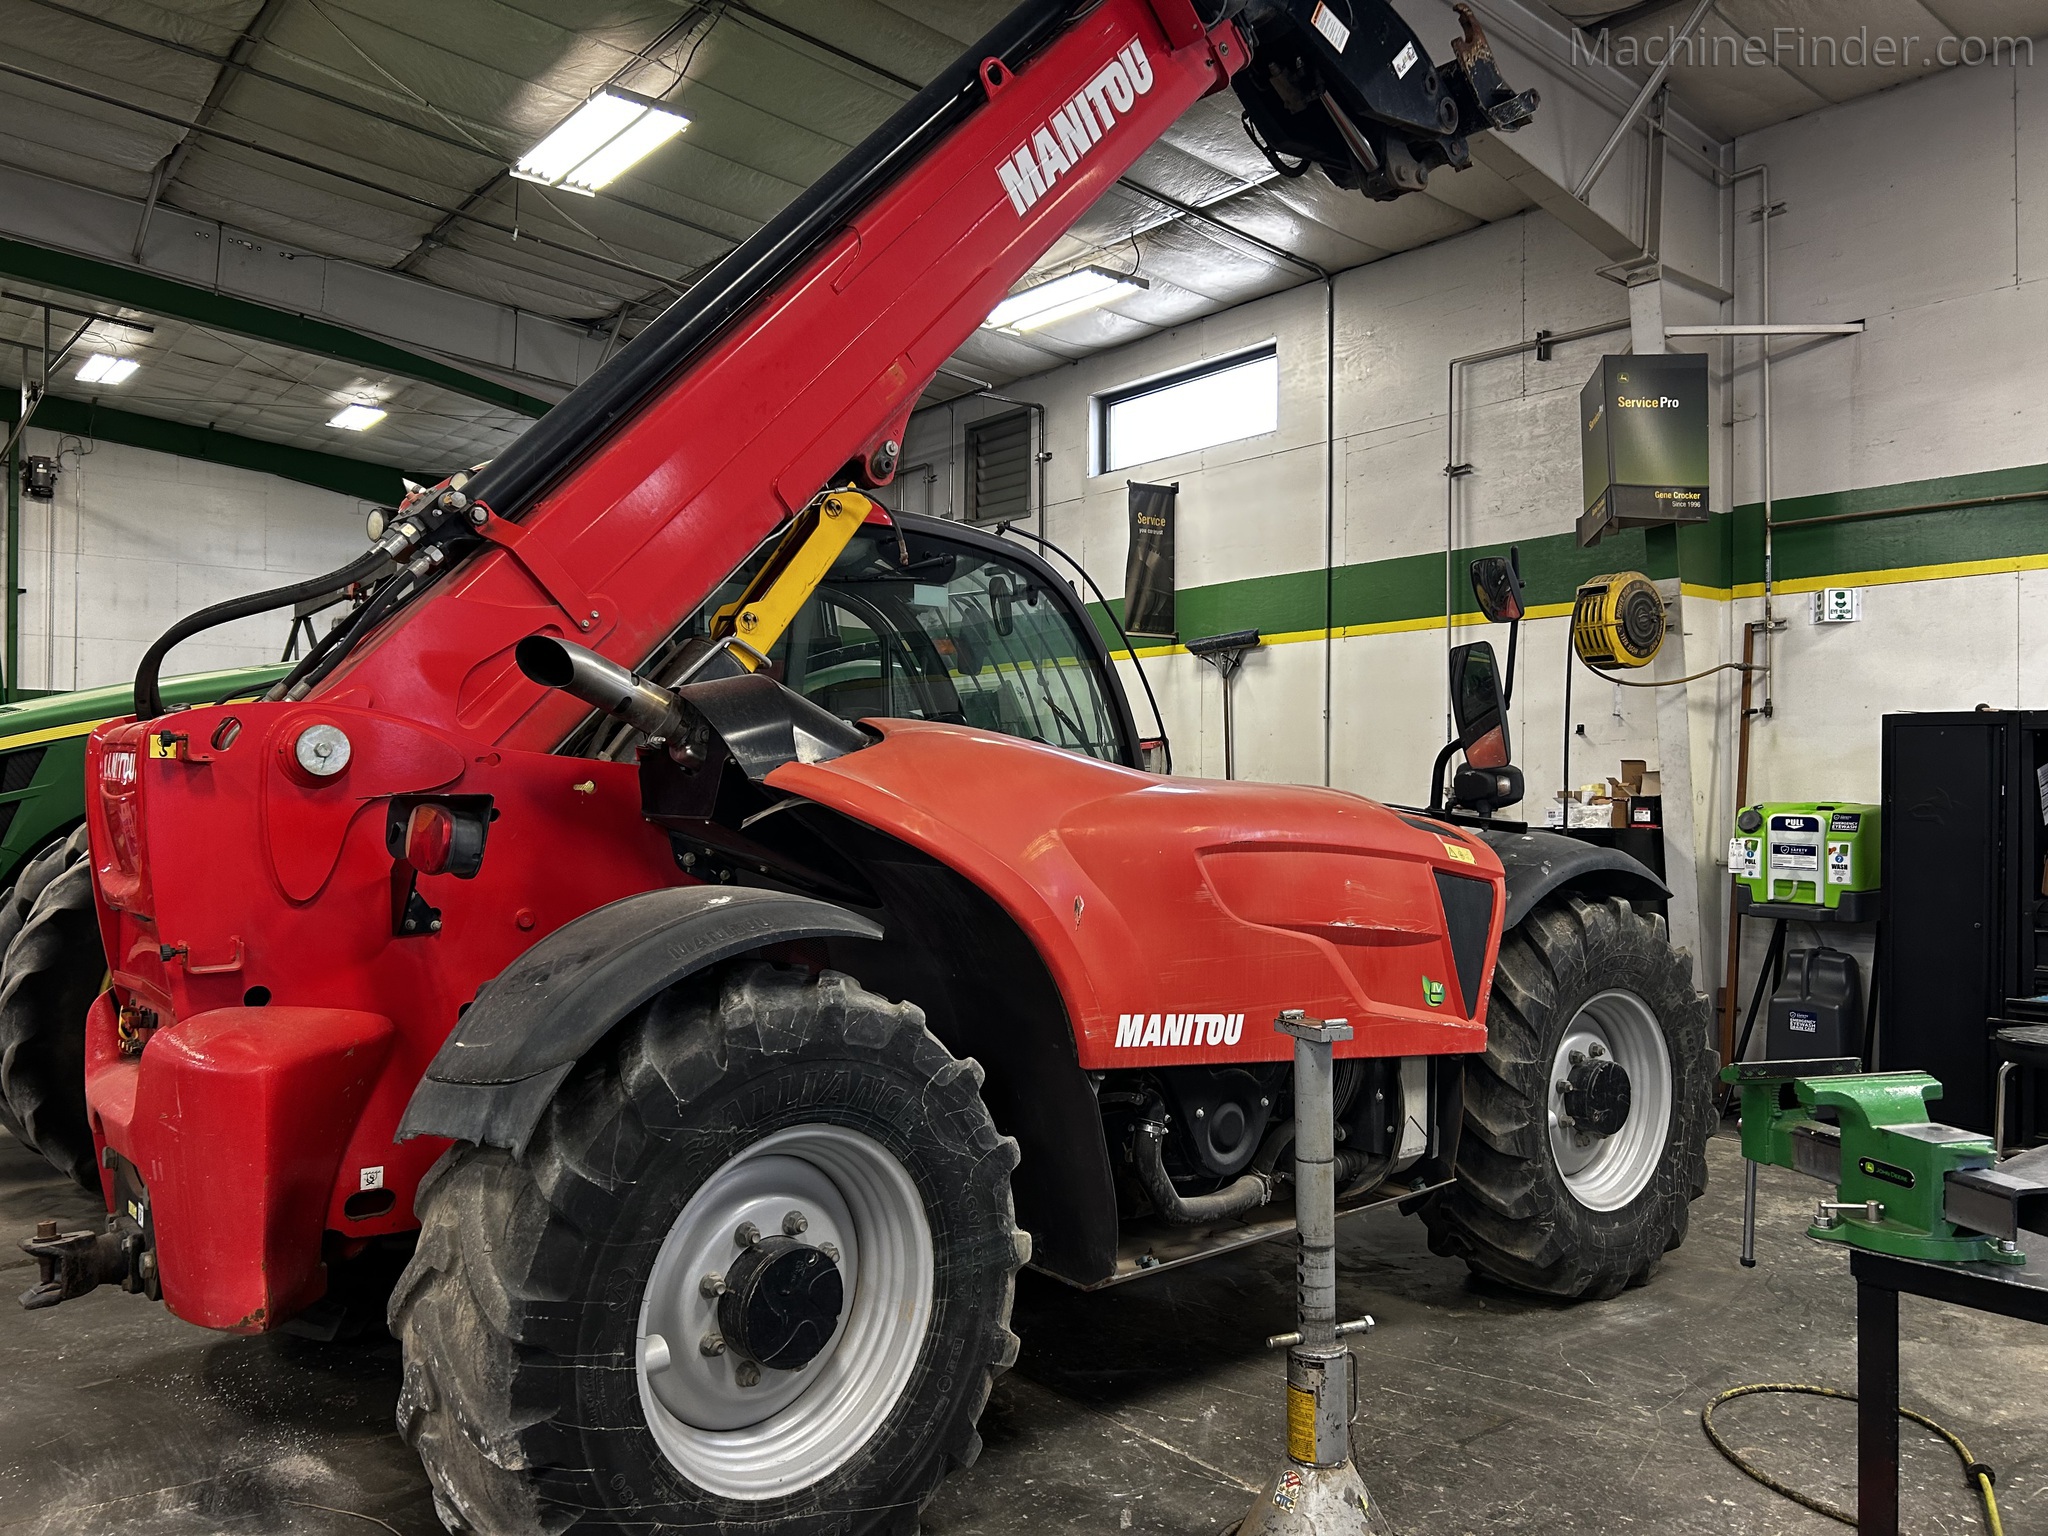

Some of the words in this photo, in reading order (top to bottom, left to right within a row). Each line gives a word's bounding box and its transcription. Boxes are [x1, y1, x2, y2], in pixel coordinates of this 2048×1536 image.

[997, 37, 1154, 217] MANITOU
[1654, 491, 1672, 499] Gene
[1673, 491, 1701, 500] Crocker
[1671, 500, 1687, 508] Since
[1138, 512, 1166, 527] Service
[1785, 818, 1804, 826] PULL
[1114, 1013, 1245, 1048] MANITOU
[718, 1070, 928, 1142] ALLIANCE
[1890, 1171, 1908, 1183] DEERE
